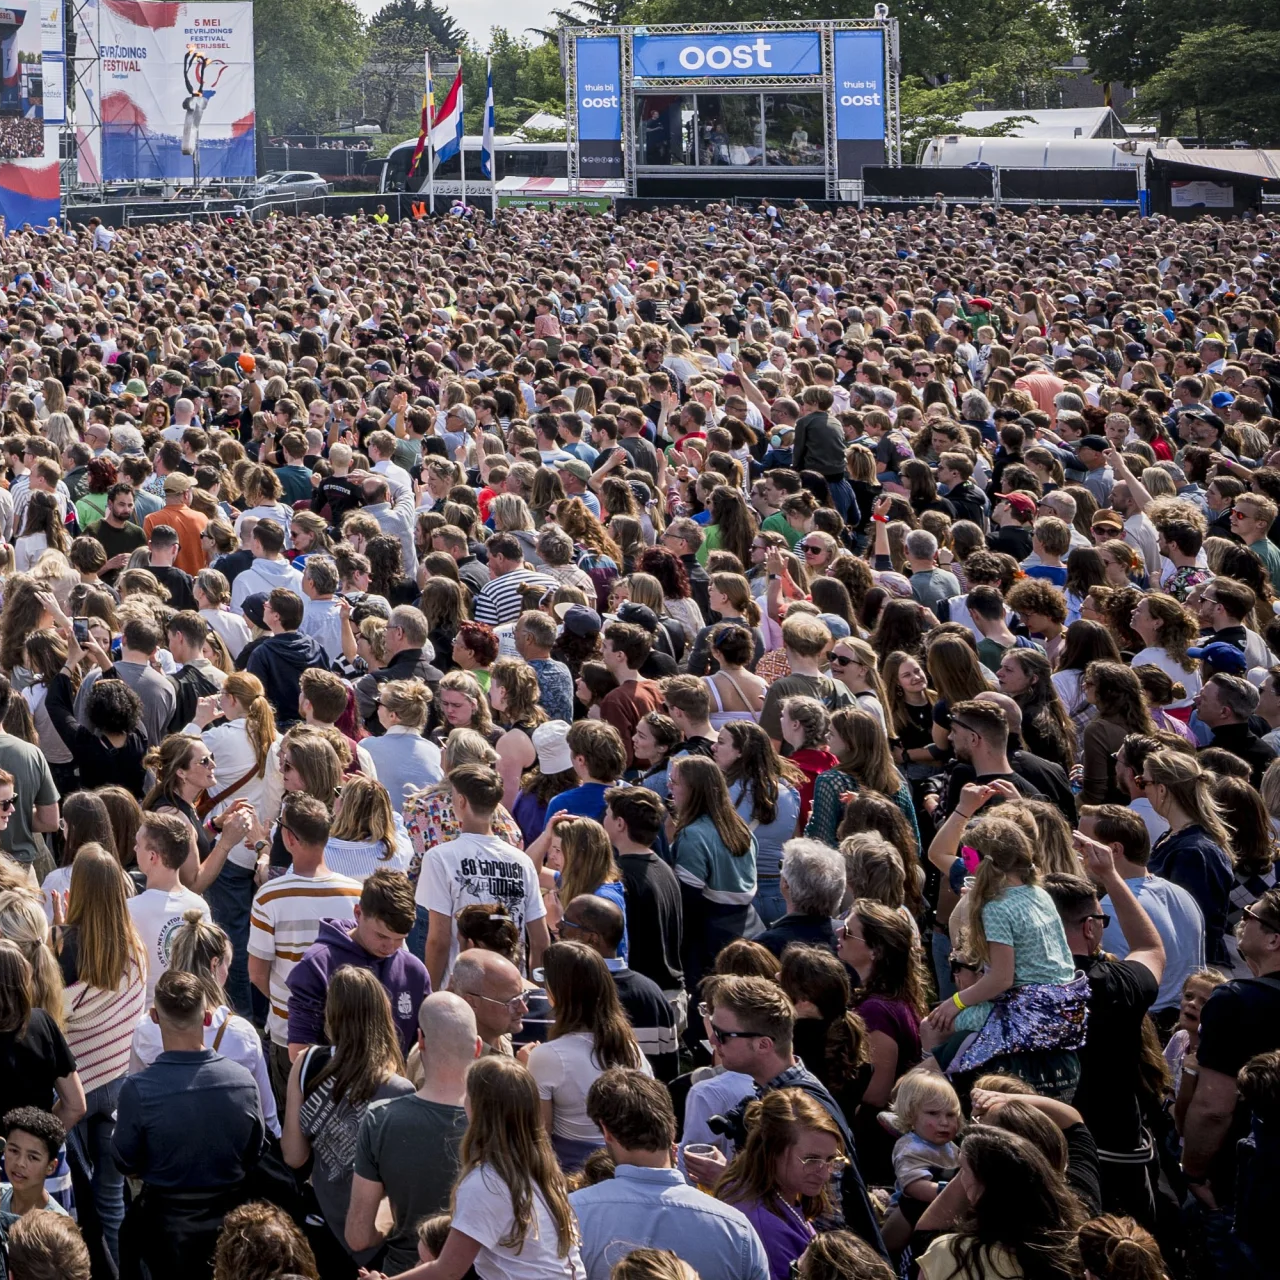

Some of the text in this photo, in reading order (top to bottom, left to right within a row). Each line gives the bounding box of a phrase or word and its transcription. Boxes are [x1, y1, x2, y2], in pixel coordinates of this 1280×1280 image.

[194, 18, 221, 27] 5 MEI
[678, 37, 772, 70] oost
[103, 59, 141, 72] FESTIVAL
[584, 83, 614, 94] thuis bij
[843, 80, 876, 90] thuis bij
[582, 95, 618, 108] oost
[840, 92, 880, 106] oost
[460, 857, 524, 880] go through
